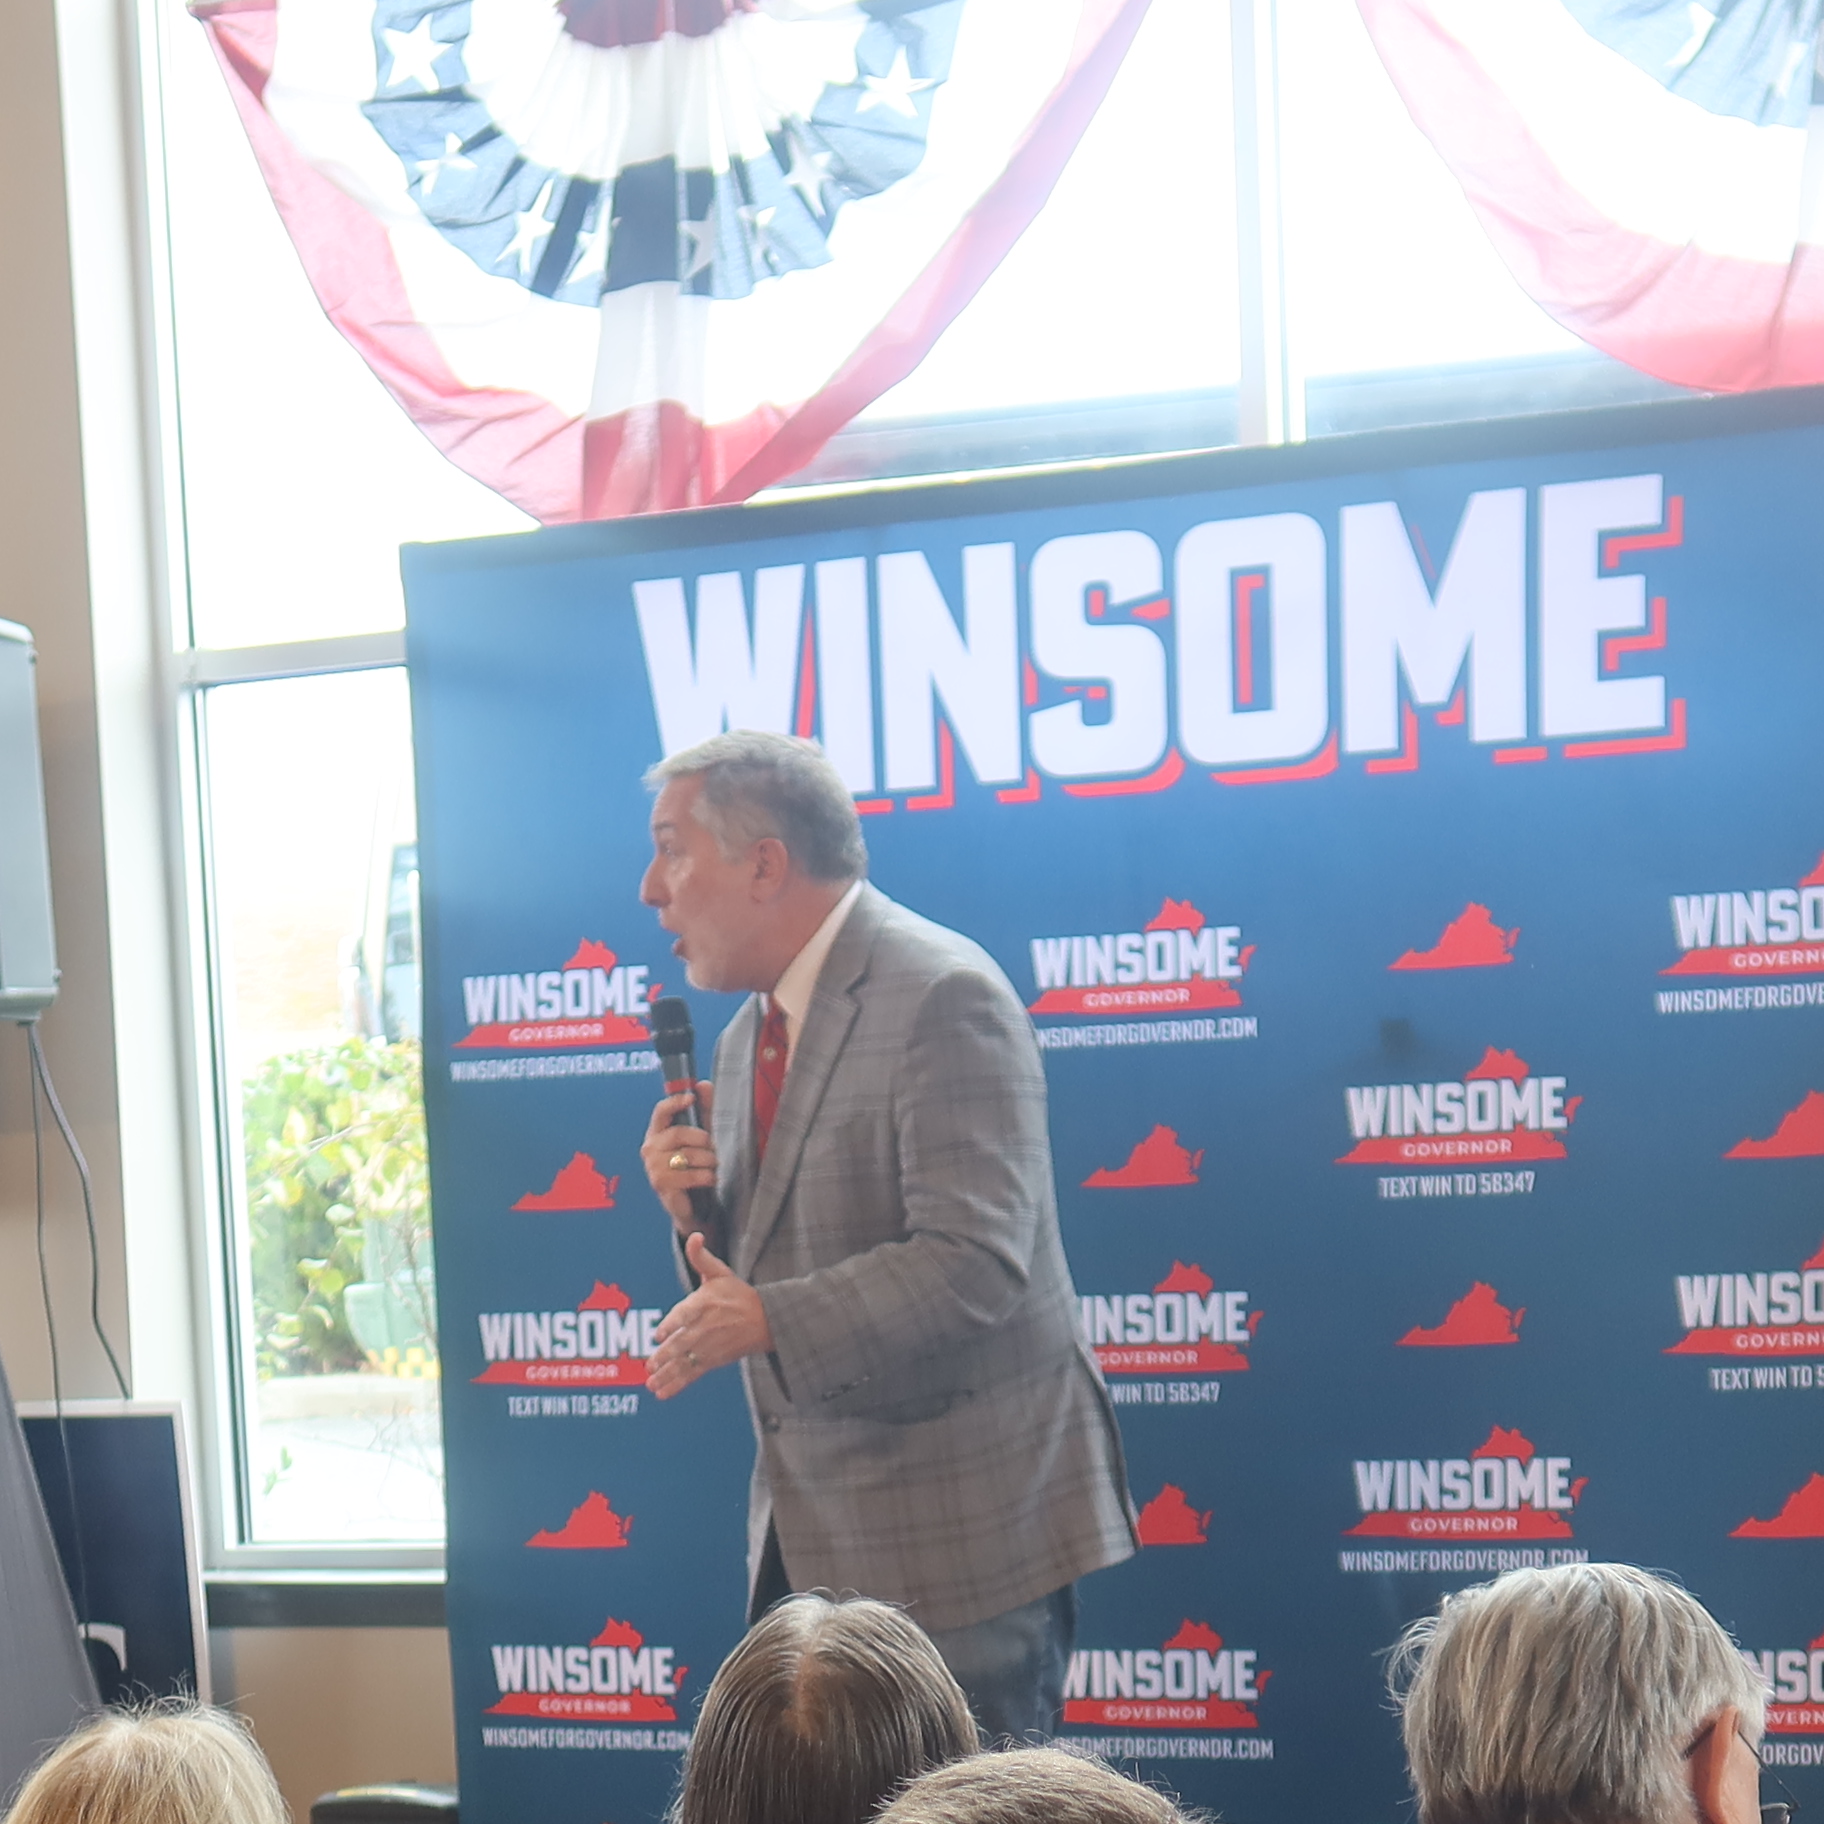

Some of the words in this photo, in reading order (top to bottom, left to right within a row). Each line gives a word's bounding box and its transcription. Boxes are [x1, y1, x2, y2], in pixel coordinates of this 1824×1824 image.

[632, 472, 1676, 803] WINSOME
[1032, 926, 1243, 990] WINSOME
[463, 965, 650, 1026] WINSOME
[1083, 987, 1192, 1008] GOVERNOR
[508, 1022, 606, 1043] GOVERNOR
[1037, 1016, 1259, 1049] NSOMEFORGOVERNOR.COM
[1347, 1076, 1568, 1139] WINSOME
[1403, 1138, 1513, 1158] GOVERNOR
[1379, 1176, 1419, 1198] TEXT
[1420, 1174, 1452, 1197] WIN
[1455, 1173, 1477, 1195] TO
[1481, 1171, 1535, 1194] 58347
[1077, 1290, 1250, 1345] INSOME
[478, 1308, 664, 1361] WINSOME
[1097, 1349, 1200, 1366] GOVERNOR
[526, 1364, 619, 1380] GOVERNOR
[1711, 1367, 1751, 1391] TEXT
[1753, 1366, 1787, 1389] WIN
[1790, 1364, 1813, 1388] TO
[507, 1396, 539, 1417] TEXT
[541, 1395, 570, 1417] WIN
[571, 1395, 589, 1416] TO
[1112, 1383, 1143, 1404] WIN
[1144, 1382, 1165, 1402] TO
[1168, 1381, 1221, 1402] 58347
[1354, 1457, 1573, 1512] WINSOME
[1409, 1516, 1519, 1533] GOVERNOR
[491, 1645, 677, 1696] WINSOME
[538, 1698, 632, 1715] GOVERNOR
[1103, 1705, 1208, 1721] GOVERNOR
